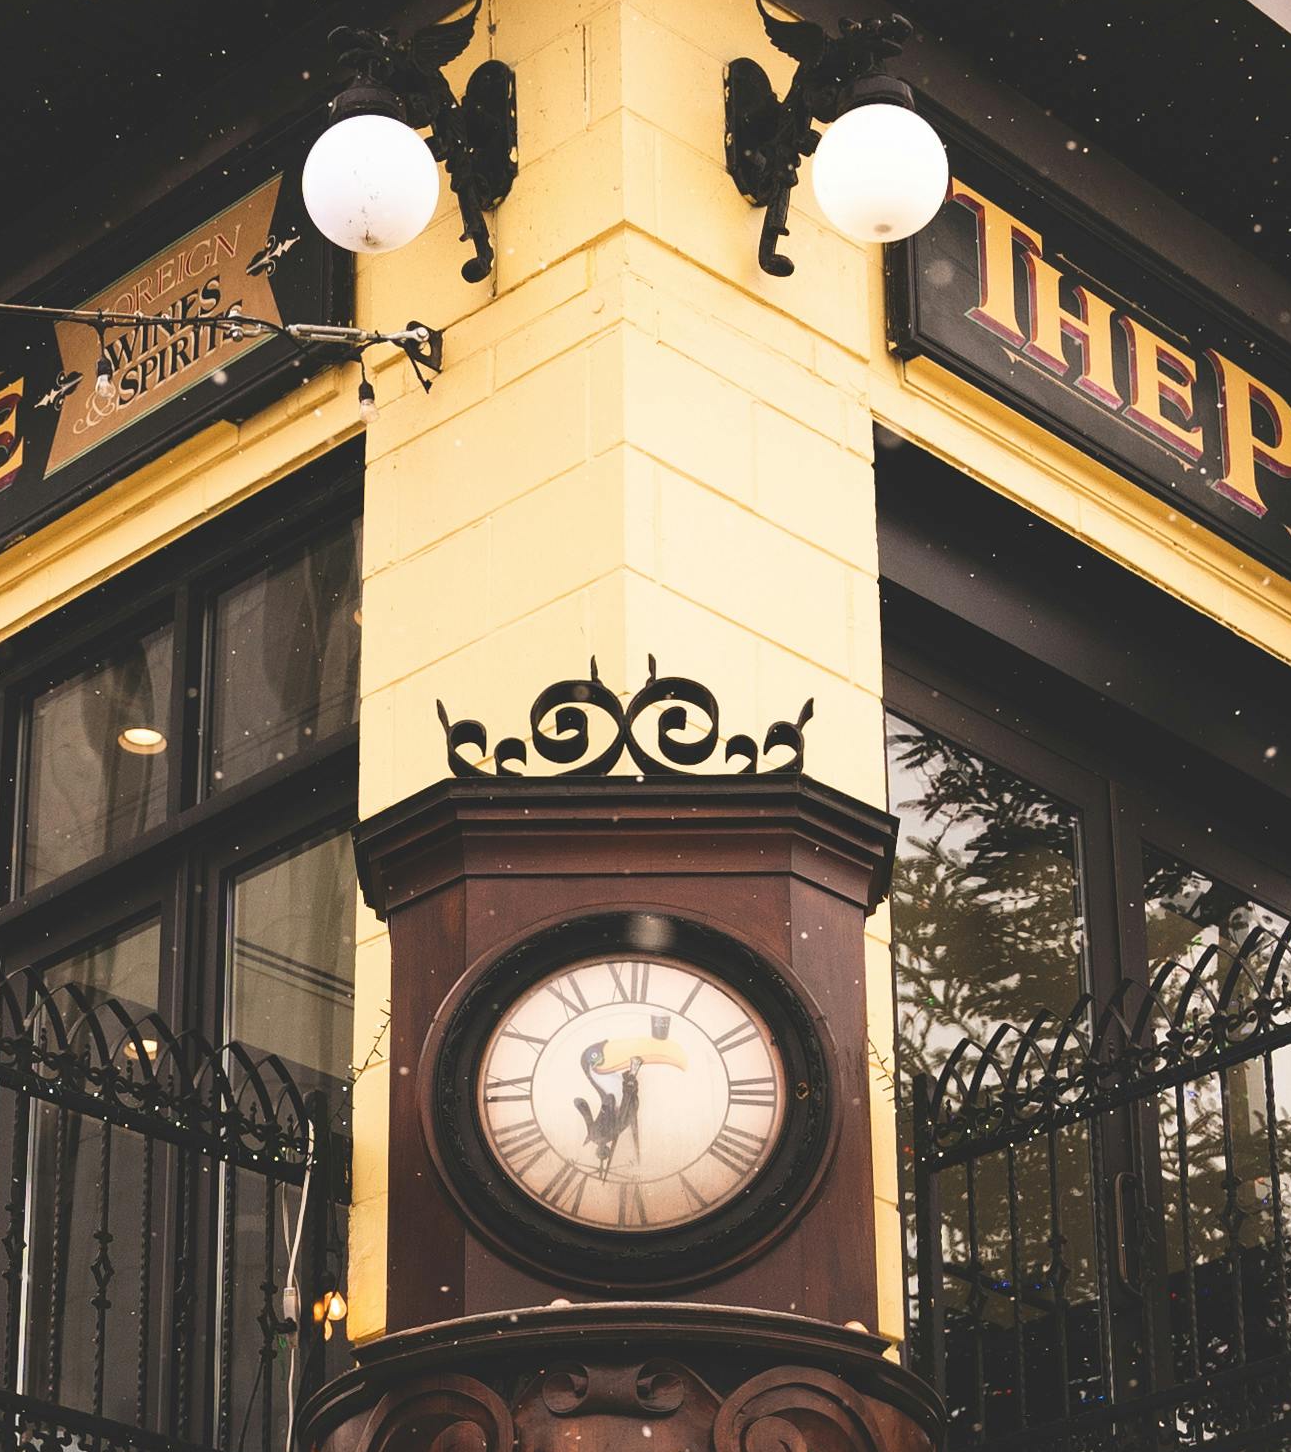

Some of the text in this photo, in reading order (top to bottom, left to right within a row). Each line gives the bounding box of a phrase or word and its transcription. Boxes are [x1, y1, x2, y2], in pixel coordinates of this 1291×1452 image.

[100, 224, 242, 323] OREIGN
[948, 174, 1206, 462] THE
[105, 275, 222, 374] WINES
